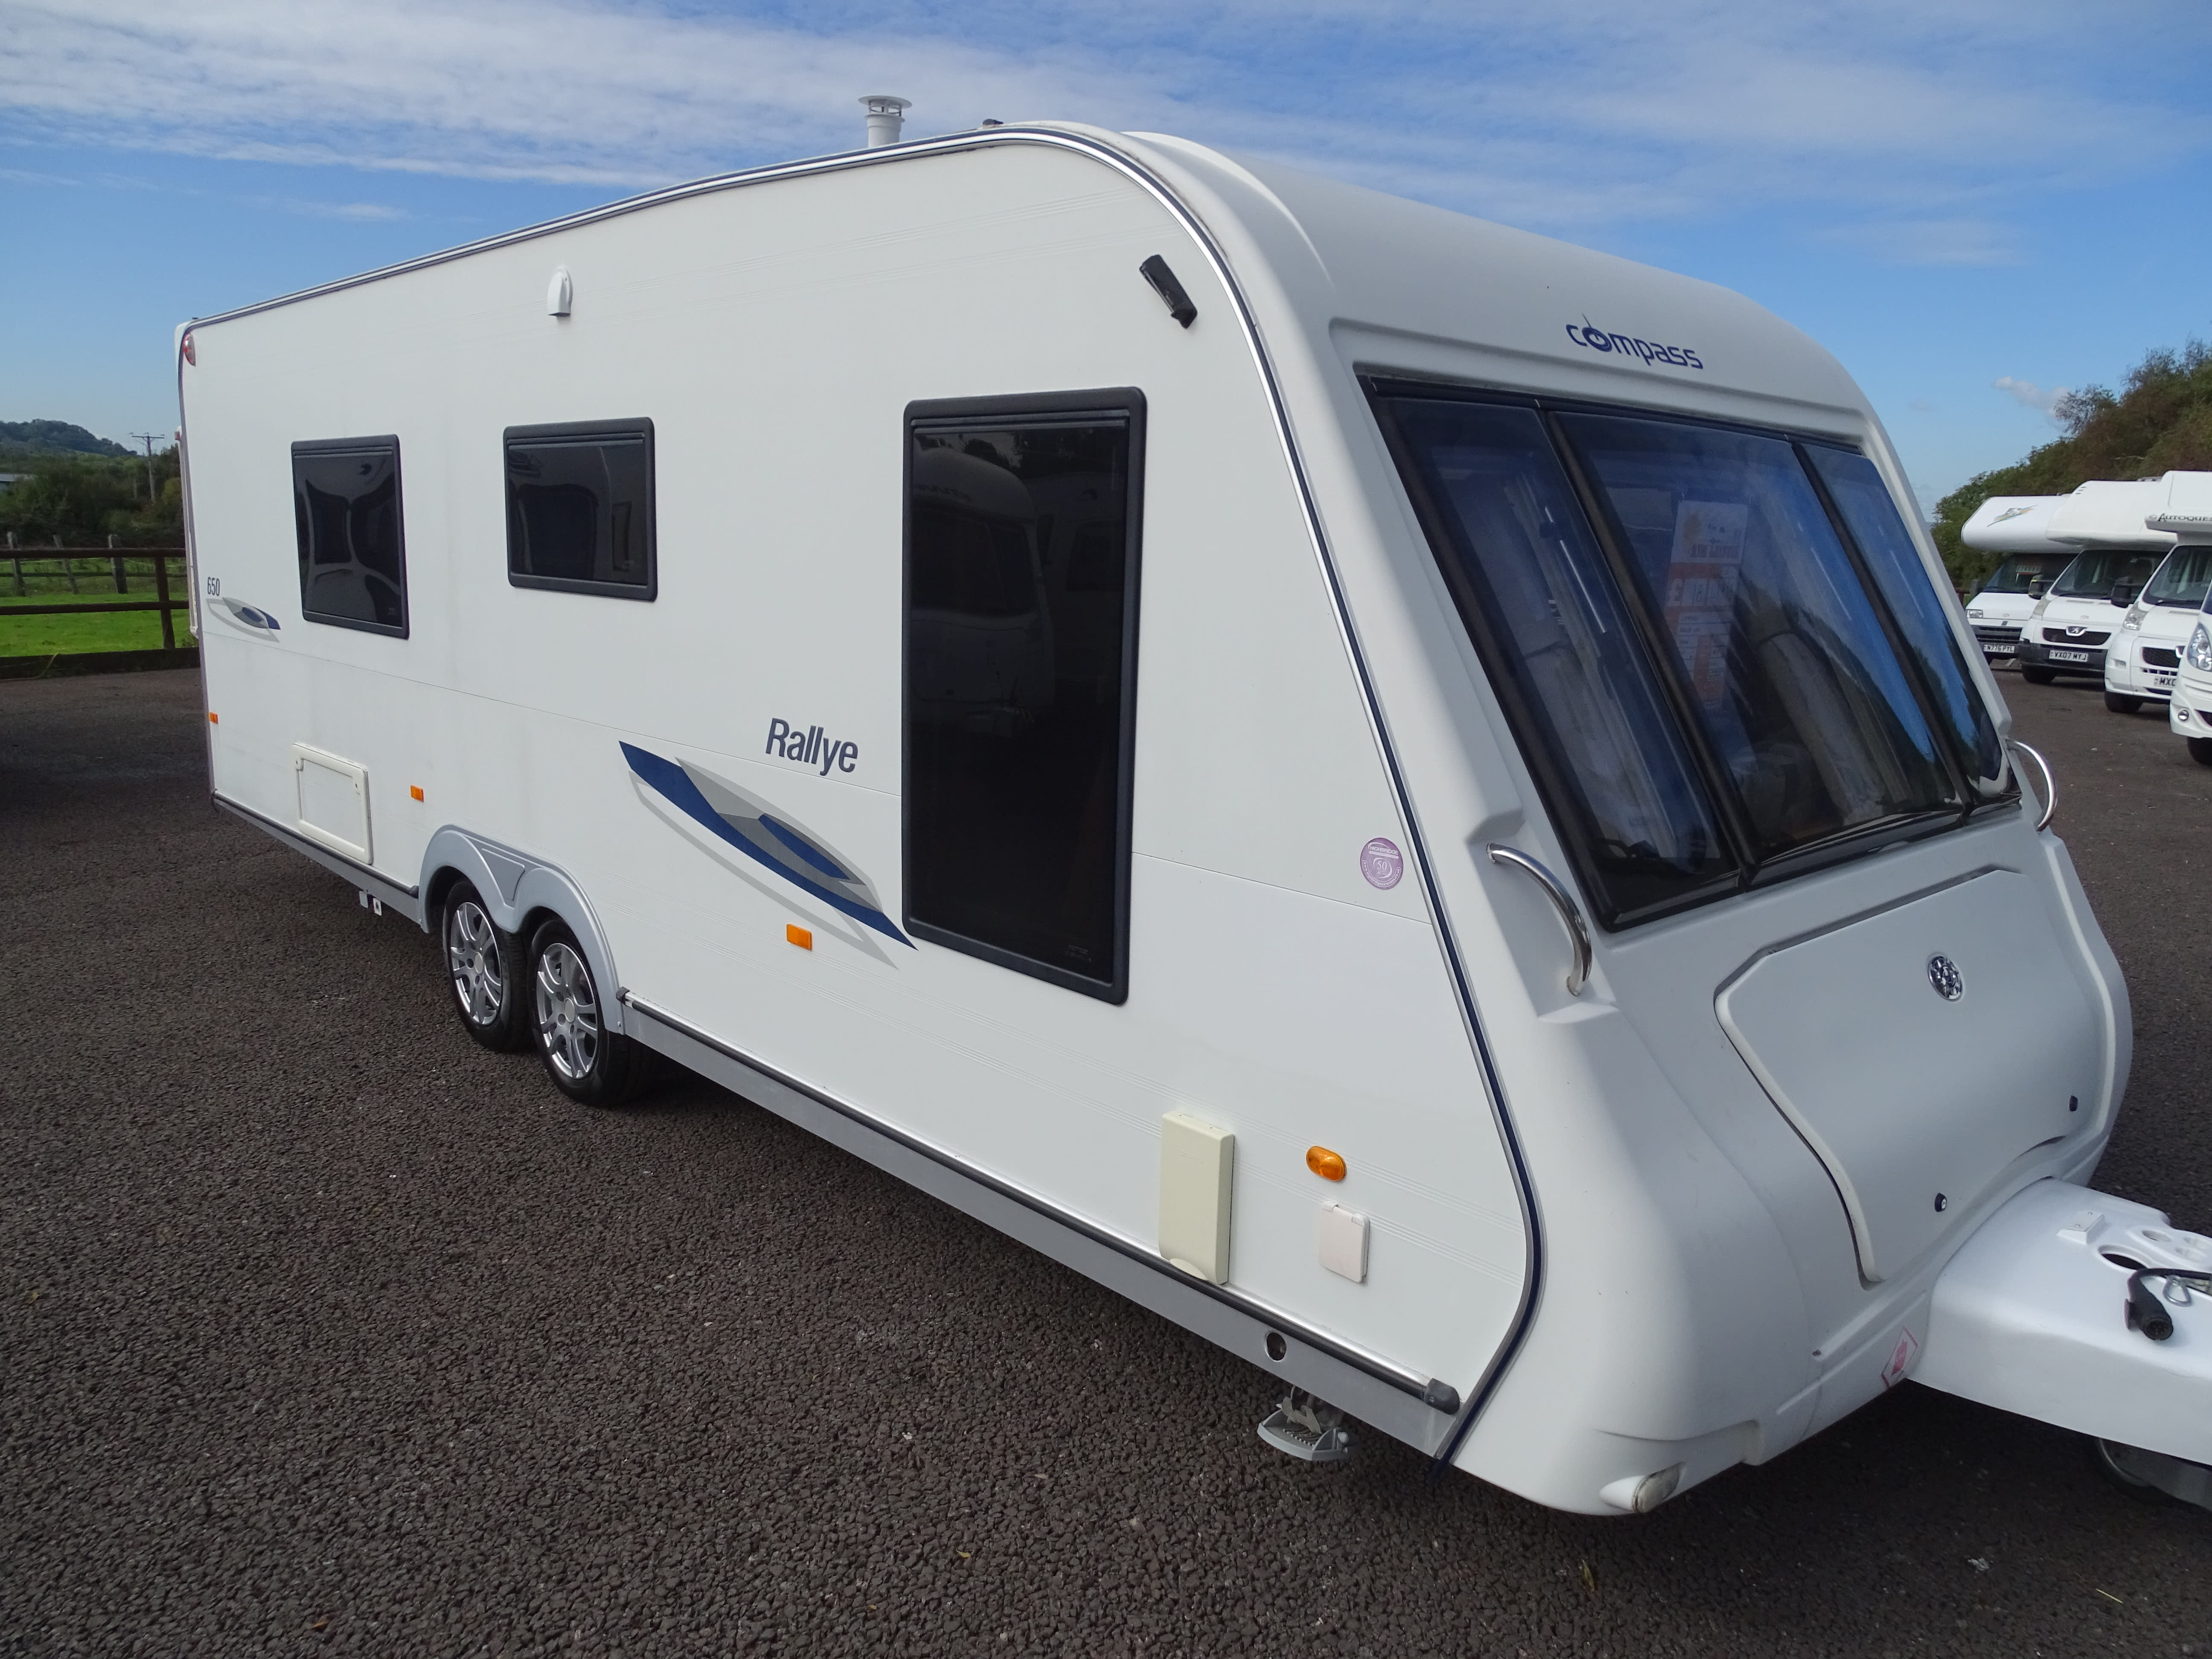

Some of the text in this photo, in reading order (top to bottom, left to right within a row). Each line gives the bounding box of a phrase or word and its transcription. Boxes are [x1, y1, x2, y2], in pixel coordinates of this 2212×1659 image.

[1566, 316, 1703, 370] compass
[207, 577, 220, 596] 650
[765, 718, 858, 776] Rallye
[1370, 846, 1398, 855] HIGHBRIDGE
[1377, 861, 1387, 870] 50
